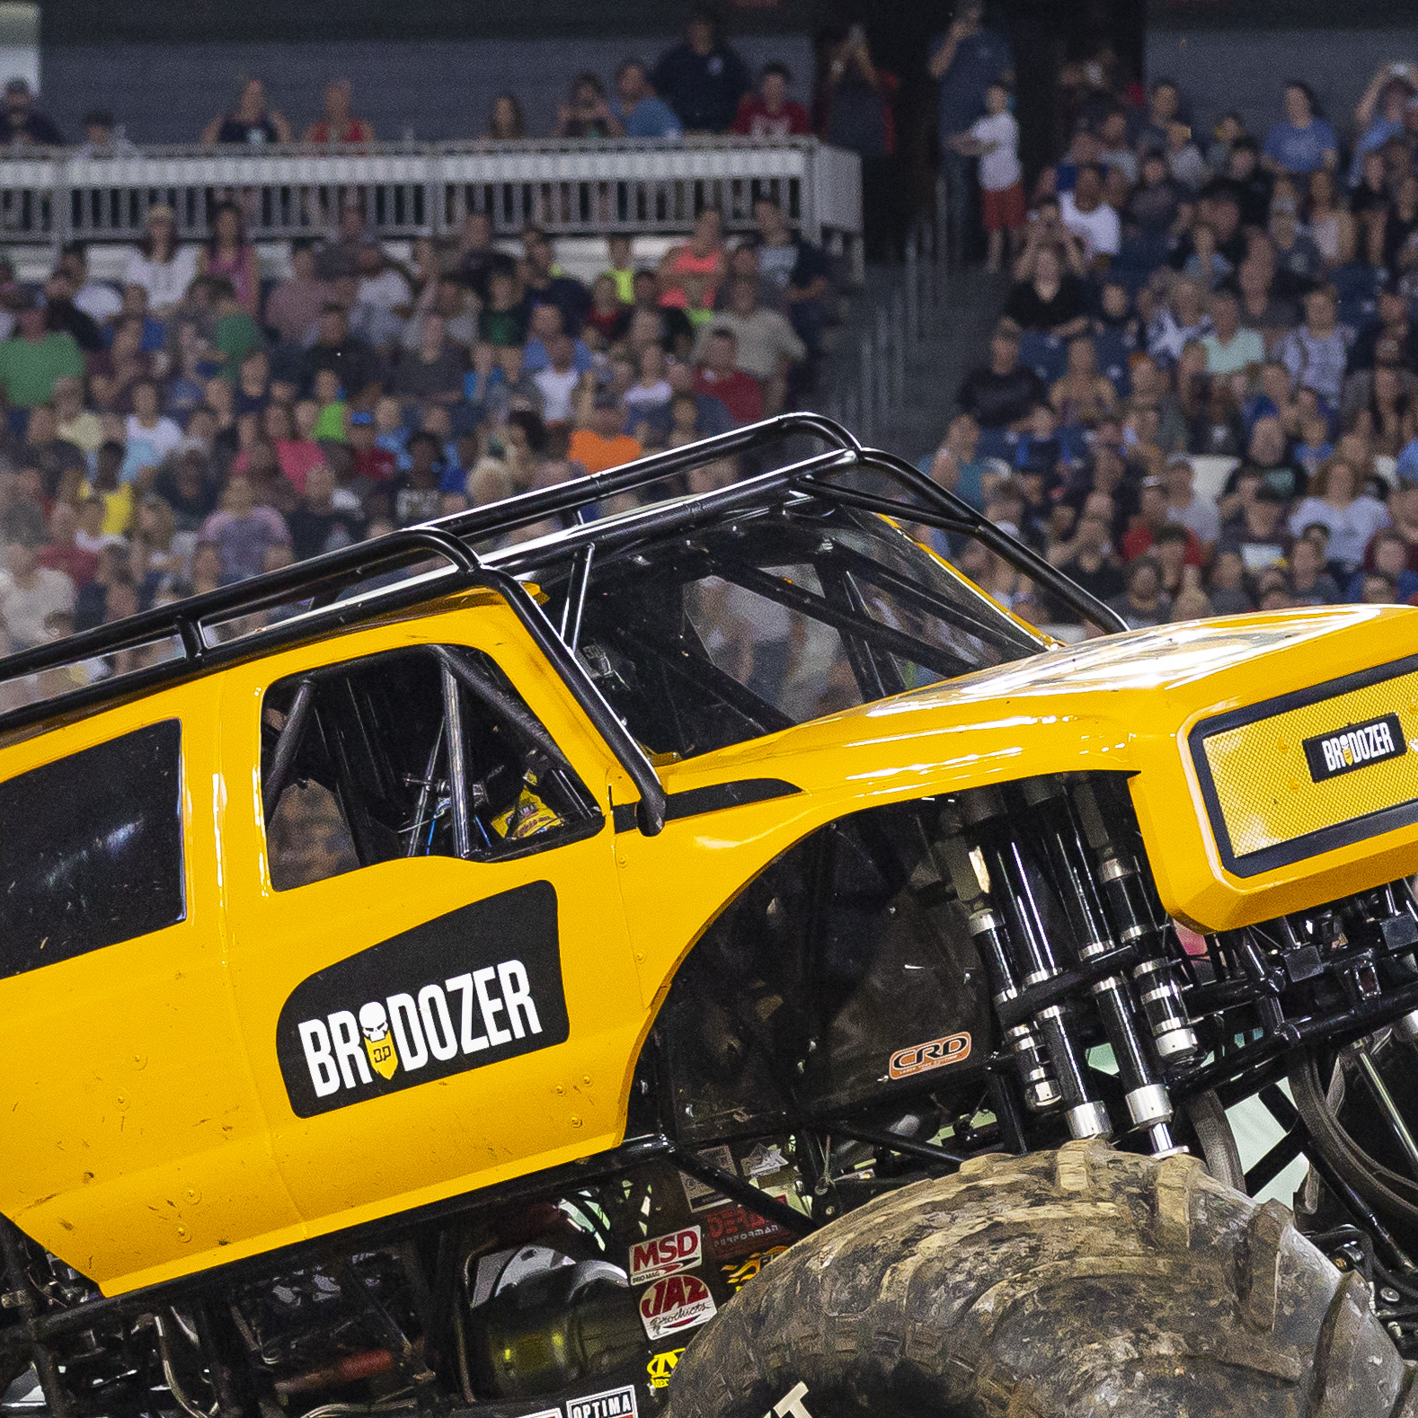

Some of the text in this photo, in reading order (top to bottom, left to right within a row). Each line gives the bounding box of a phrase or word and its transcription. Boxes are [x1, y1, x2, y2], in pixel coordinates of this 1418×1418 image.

[892, 1035, 969, 1070] CRD
[634, 1230, 699, 1273] MSD
[641, 1274, 709, 1319] JAZ
